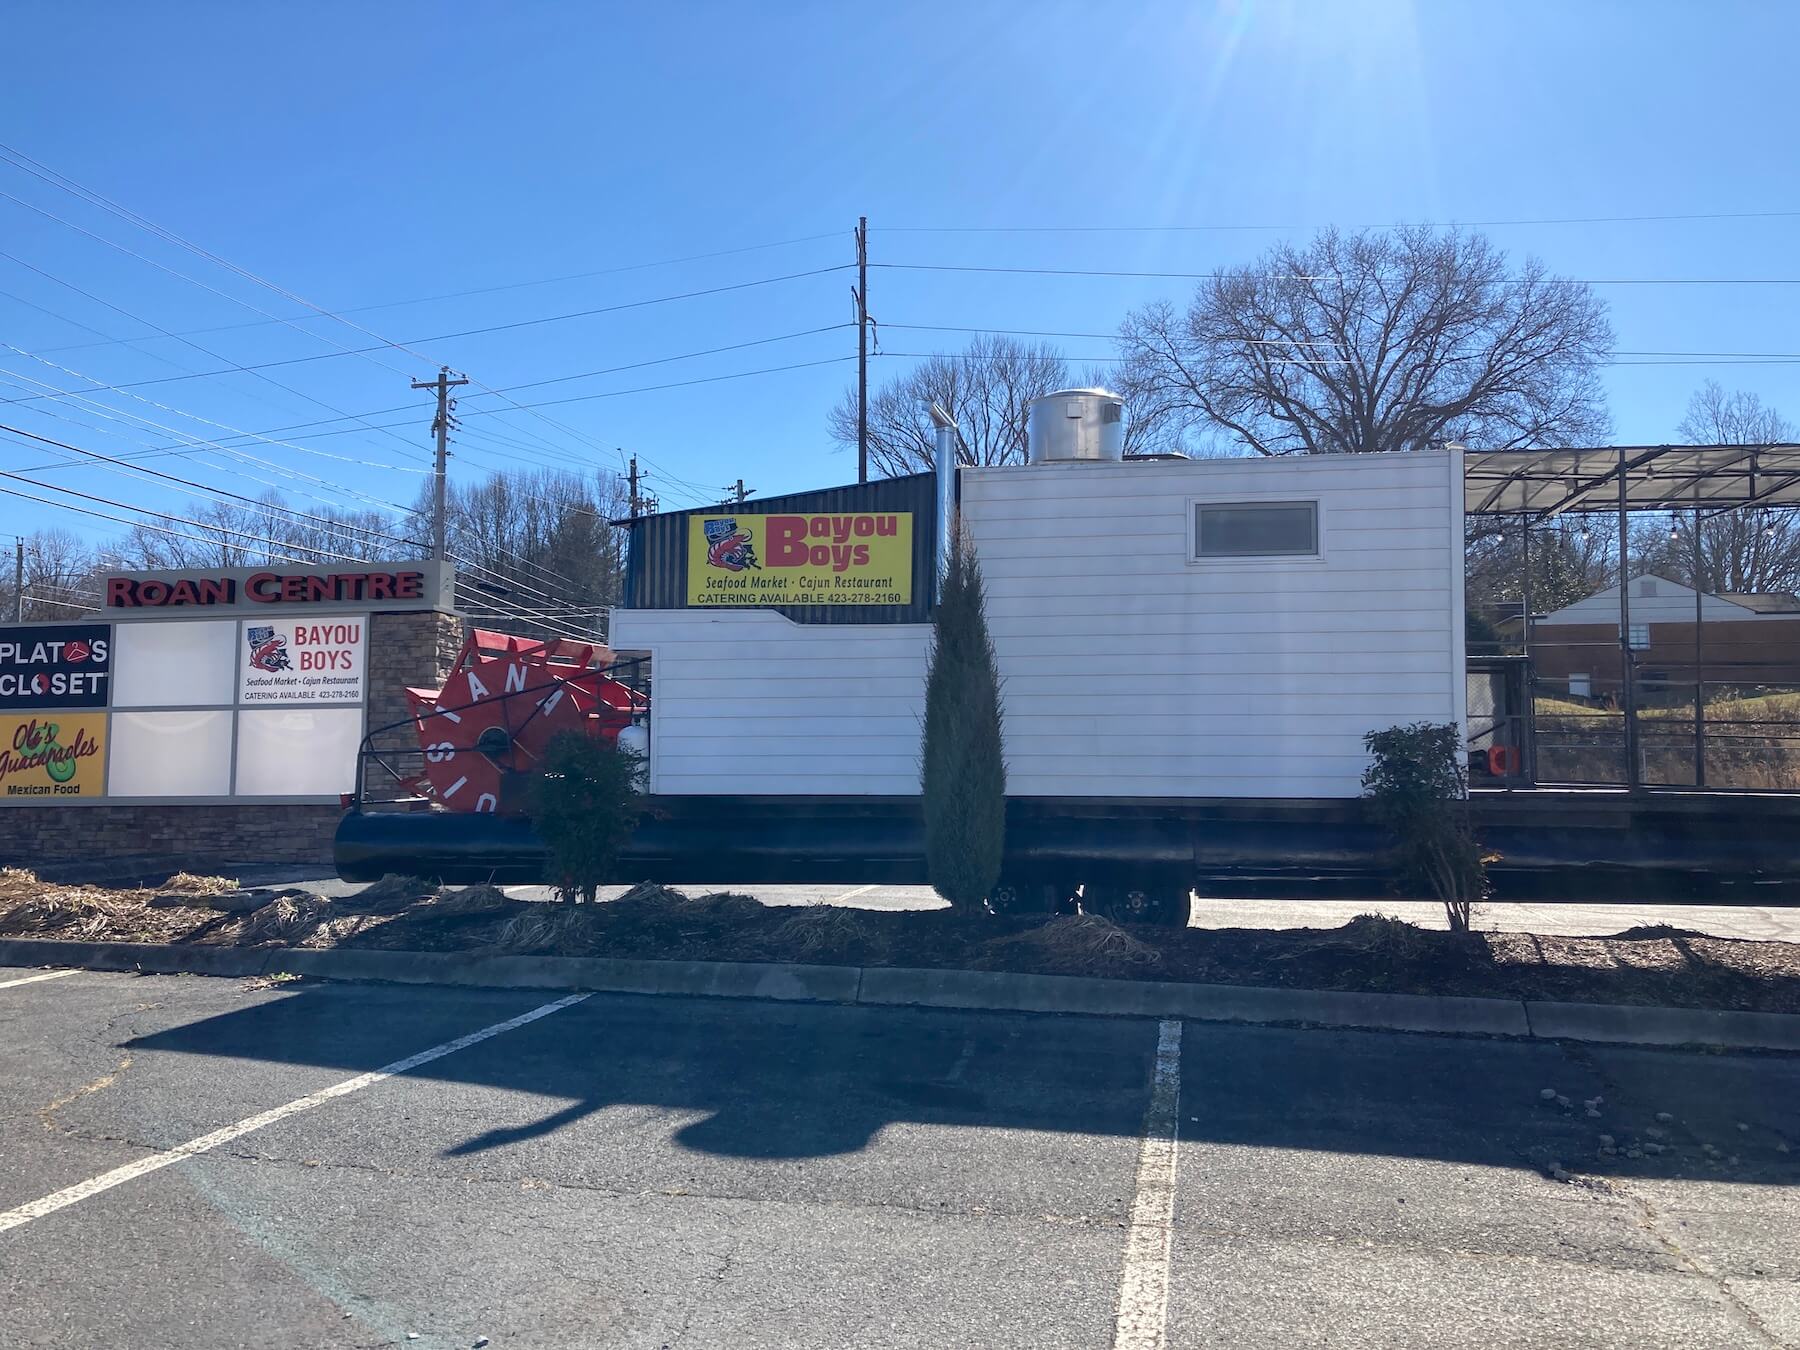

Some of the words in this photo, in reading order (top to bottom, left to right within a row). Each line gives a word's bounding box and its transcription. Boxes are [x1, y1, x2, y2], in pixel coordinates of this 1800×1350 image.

[706, 575, 746, 591] Seafood
[750, 576, 788, 589] Market
[799, 576, 830, 591] Cajun
[834, 575, 893, 589] Restaurant
[697, 593, 756, 604] CATERING
[759, 593, 825, 604] AVAILABLE
[828, 593, 901, 604] 423-278-2160
[295, 624, 360, 646] BAYOU
[0, 639, 107, 664] PLATO'S
[300, 650, 352, 671] BOYS
[0, 672, 105, 696] CLOSET
[246, 677, 272, 687] Seafood
[274, 676, 298, 686] Market
[302, 676, 321, 687] Cajun
[323, 675, 359, 685] Restaurant
[244, 691, 278, 700] CATERING
[279, 690, 316, 699] AVAILABLE
[318, 690, 359, 699] 423-278-2160
[7, 784, 51, 795] Mexican
[54, 783, 80, 794] Food
